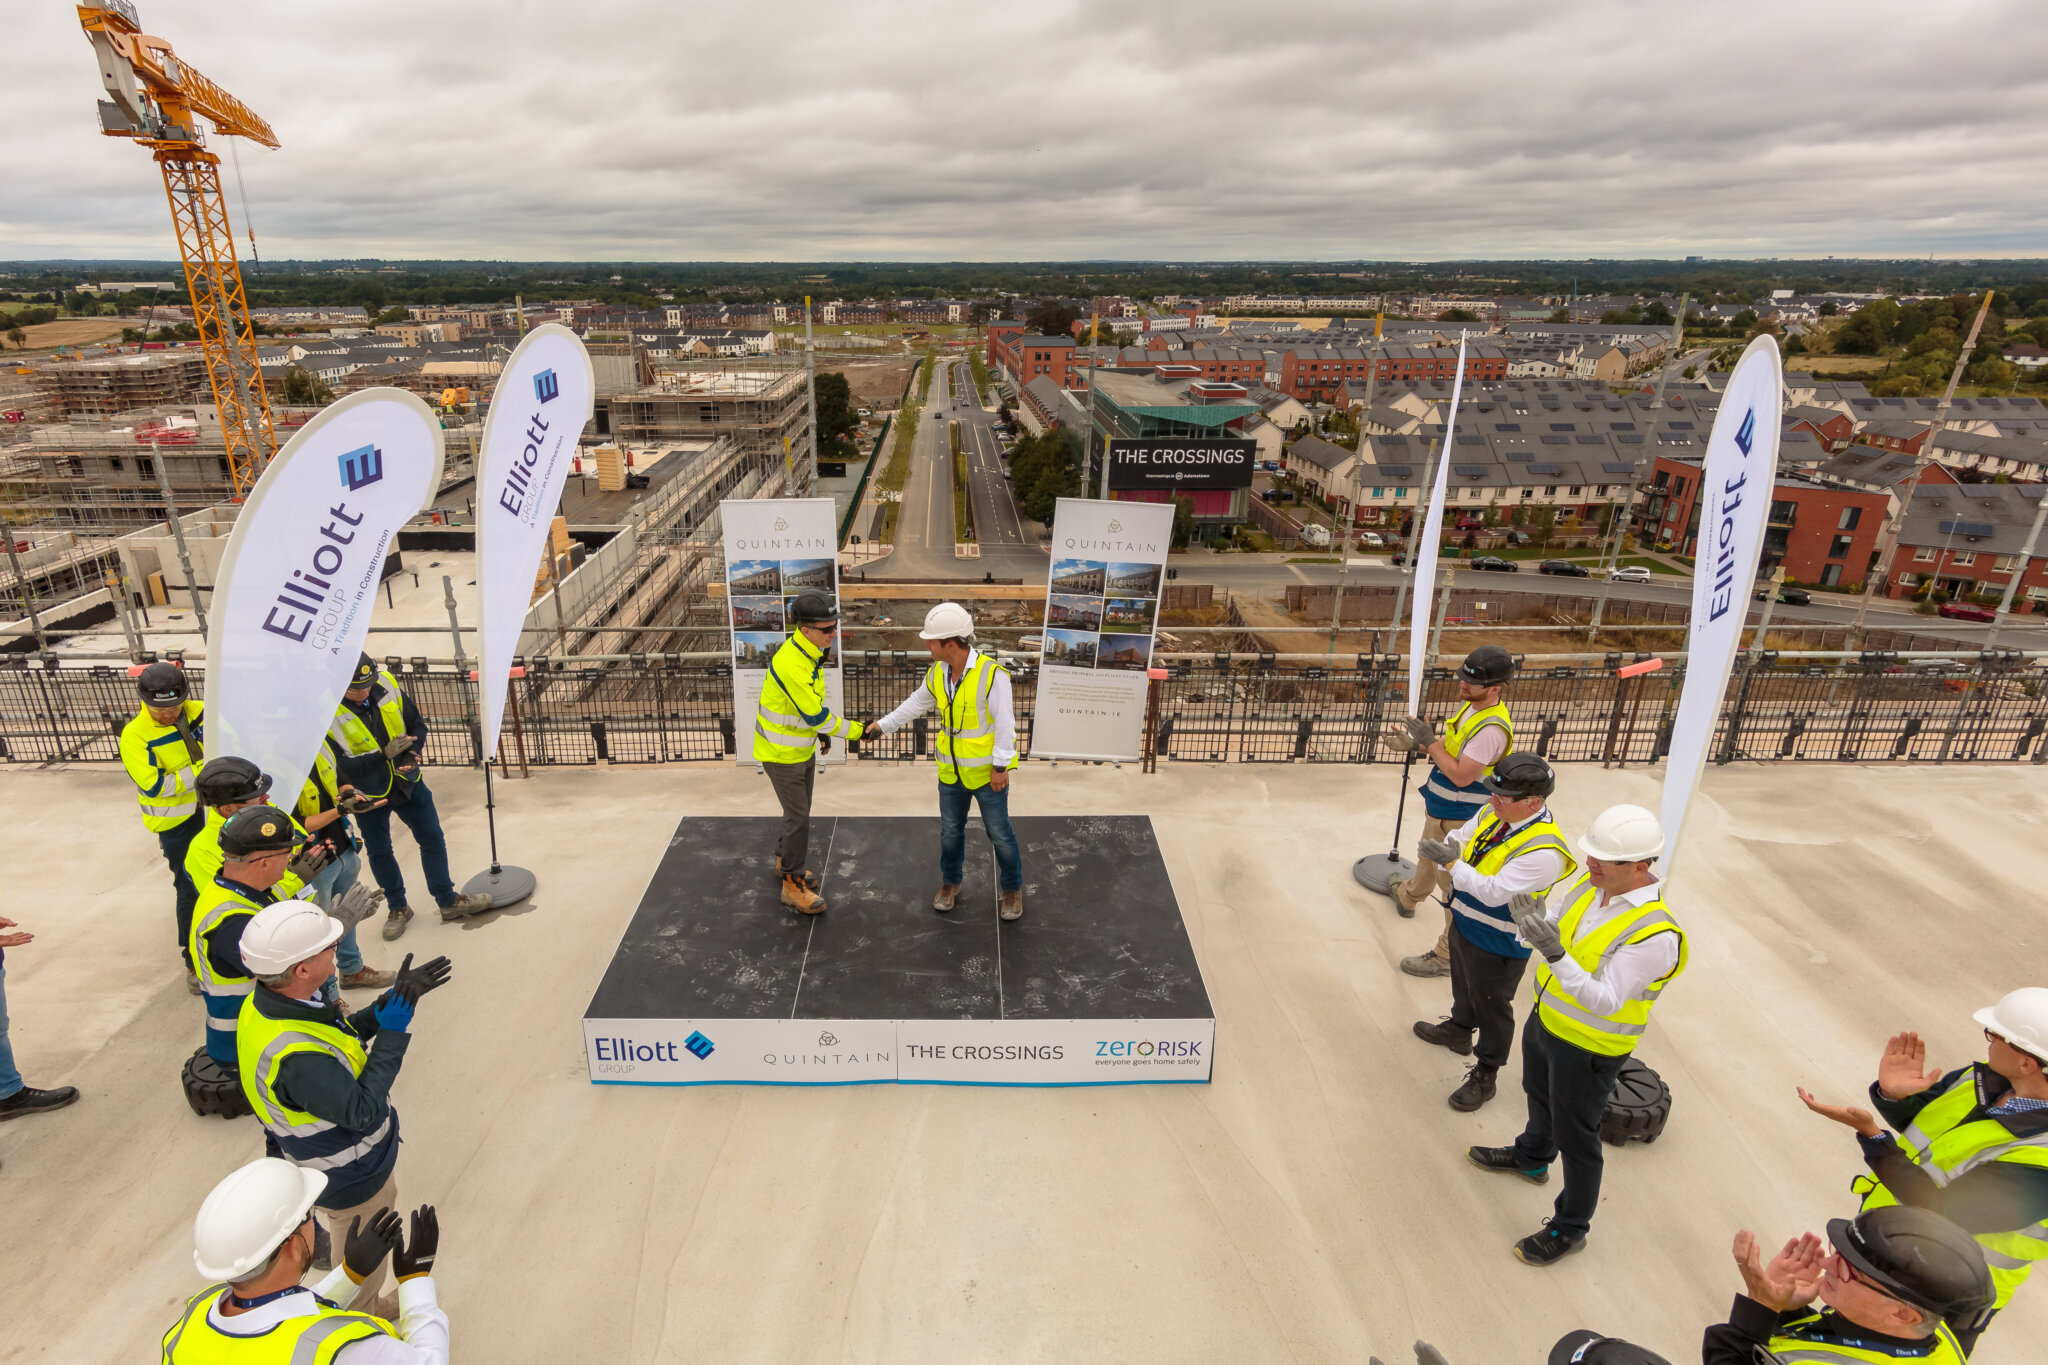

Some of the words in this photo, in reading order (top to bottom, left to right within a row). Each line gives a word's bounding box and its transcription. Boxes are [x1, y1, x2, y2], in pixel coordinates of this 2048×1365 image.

[1115, 449, 1148, 464] THE
[1152, 449, 1245, 464] CROSSINGS
[499, 412, 549, 517] Elliott
[532, 489, 544, 520] Tradition
[544, 435, 564, 480] Construction
[520, 477, 539, 524] GROUP
[736, 538, 825, 550] QUINTAIN
[1065, 538, 1157, 553] QUINTAIN
[359, 528, 389, 590] Construction
[262, 502, 364, 643] Elliott
[356, 591, 364, 601] in
[311, 588, 347, 650] GROUP
[334, 602, 359, 644] Tradition
[330, 646, 340, 656] A
[595, 1038, 679, 1062] Elliott
[906, 1045, 946, 1059] THE
[952, 1045, 1064, 1060] CROSSINGS
[763, 1052, 889, 1066] QUINTAIN
[1095, 1059, 1131, 1067] everyone
[1177, 1058, 1201, 1066] safely
[598, 1063, 635, 1074] GROUP
[1895, 1348, 1912, 1357] Elliott
